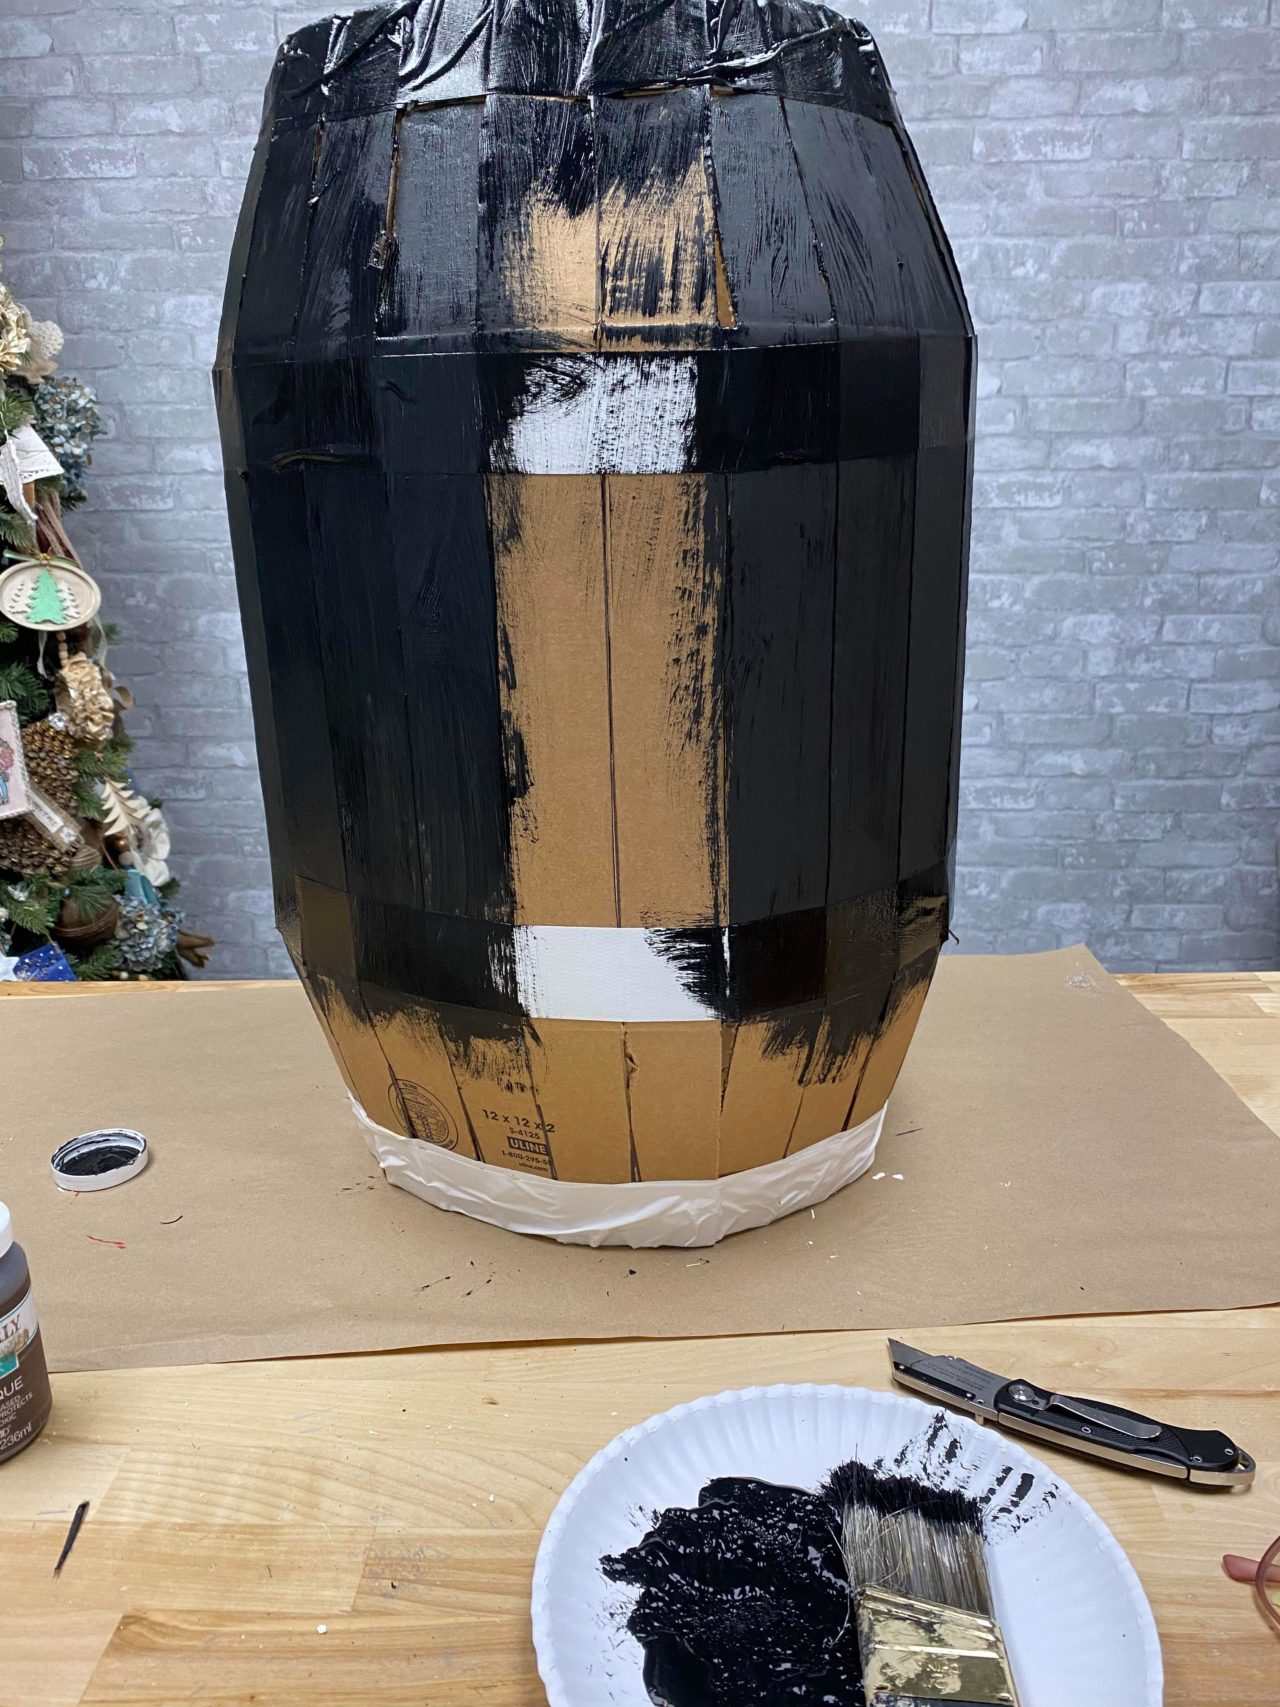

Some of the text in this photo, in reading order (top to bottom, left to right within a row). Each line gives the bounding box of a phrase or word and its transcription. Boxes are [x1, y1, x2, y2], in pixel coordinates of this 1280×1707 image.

[482, 1109, 499, 1120] 12
[502, 1115, 510, 1123] x
[514, 1116, 530, 1127] 12
[545, 1123, 555, 1133] 2
[510, 1138, 547, 1154] ULINE
[0, 1314, 21, 1343] LY
